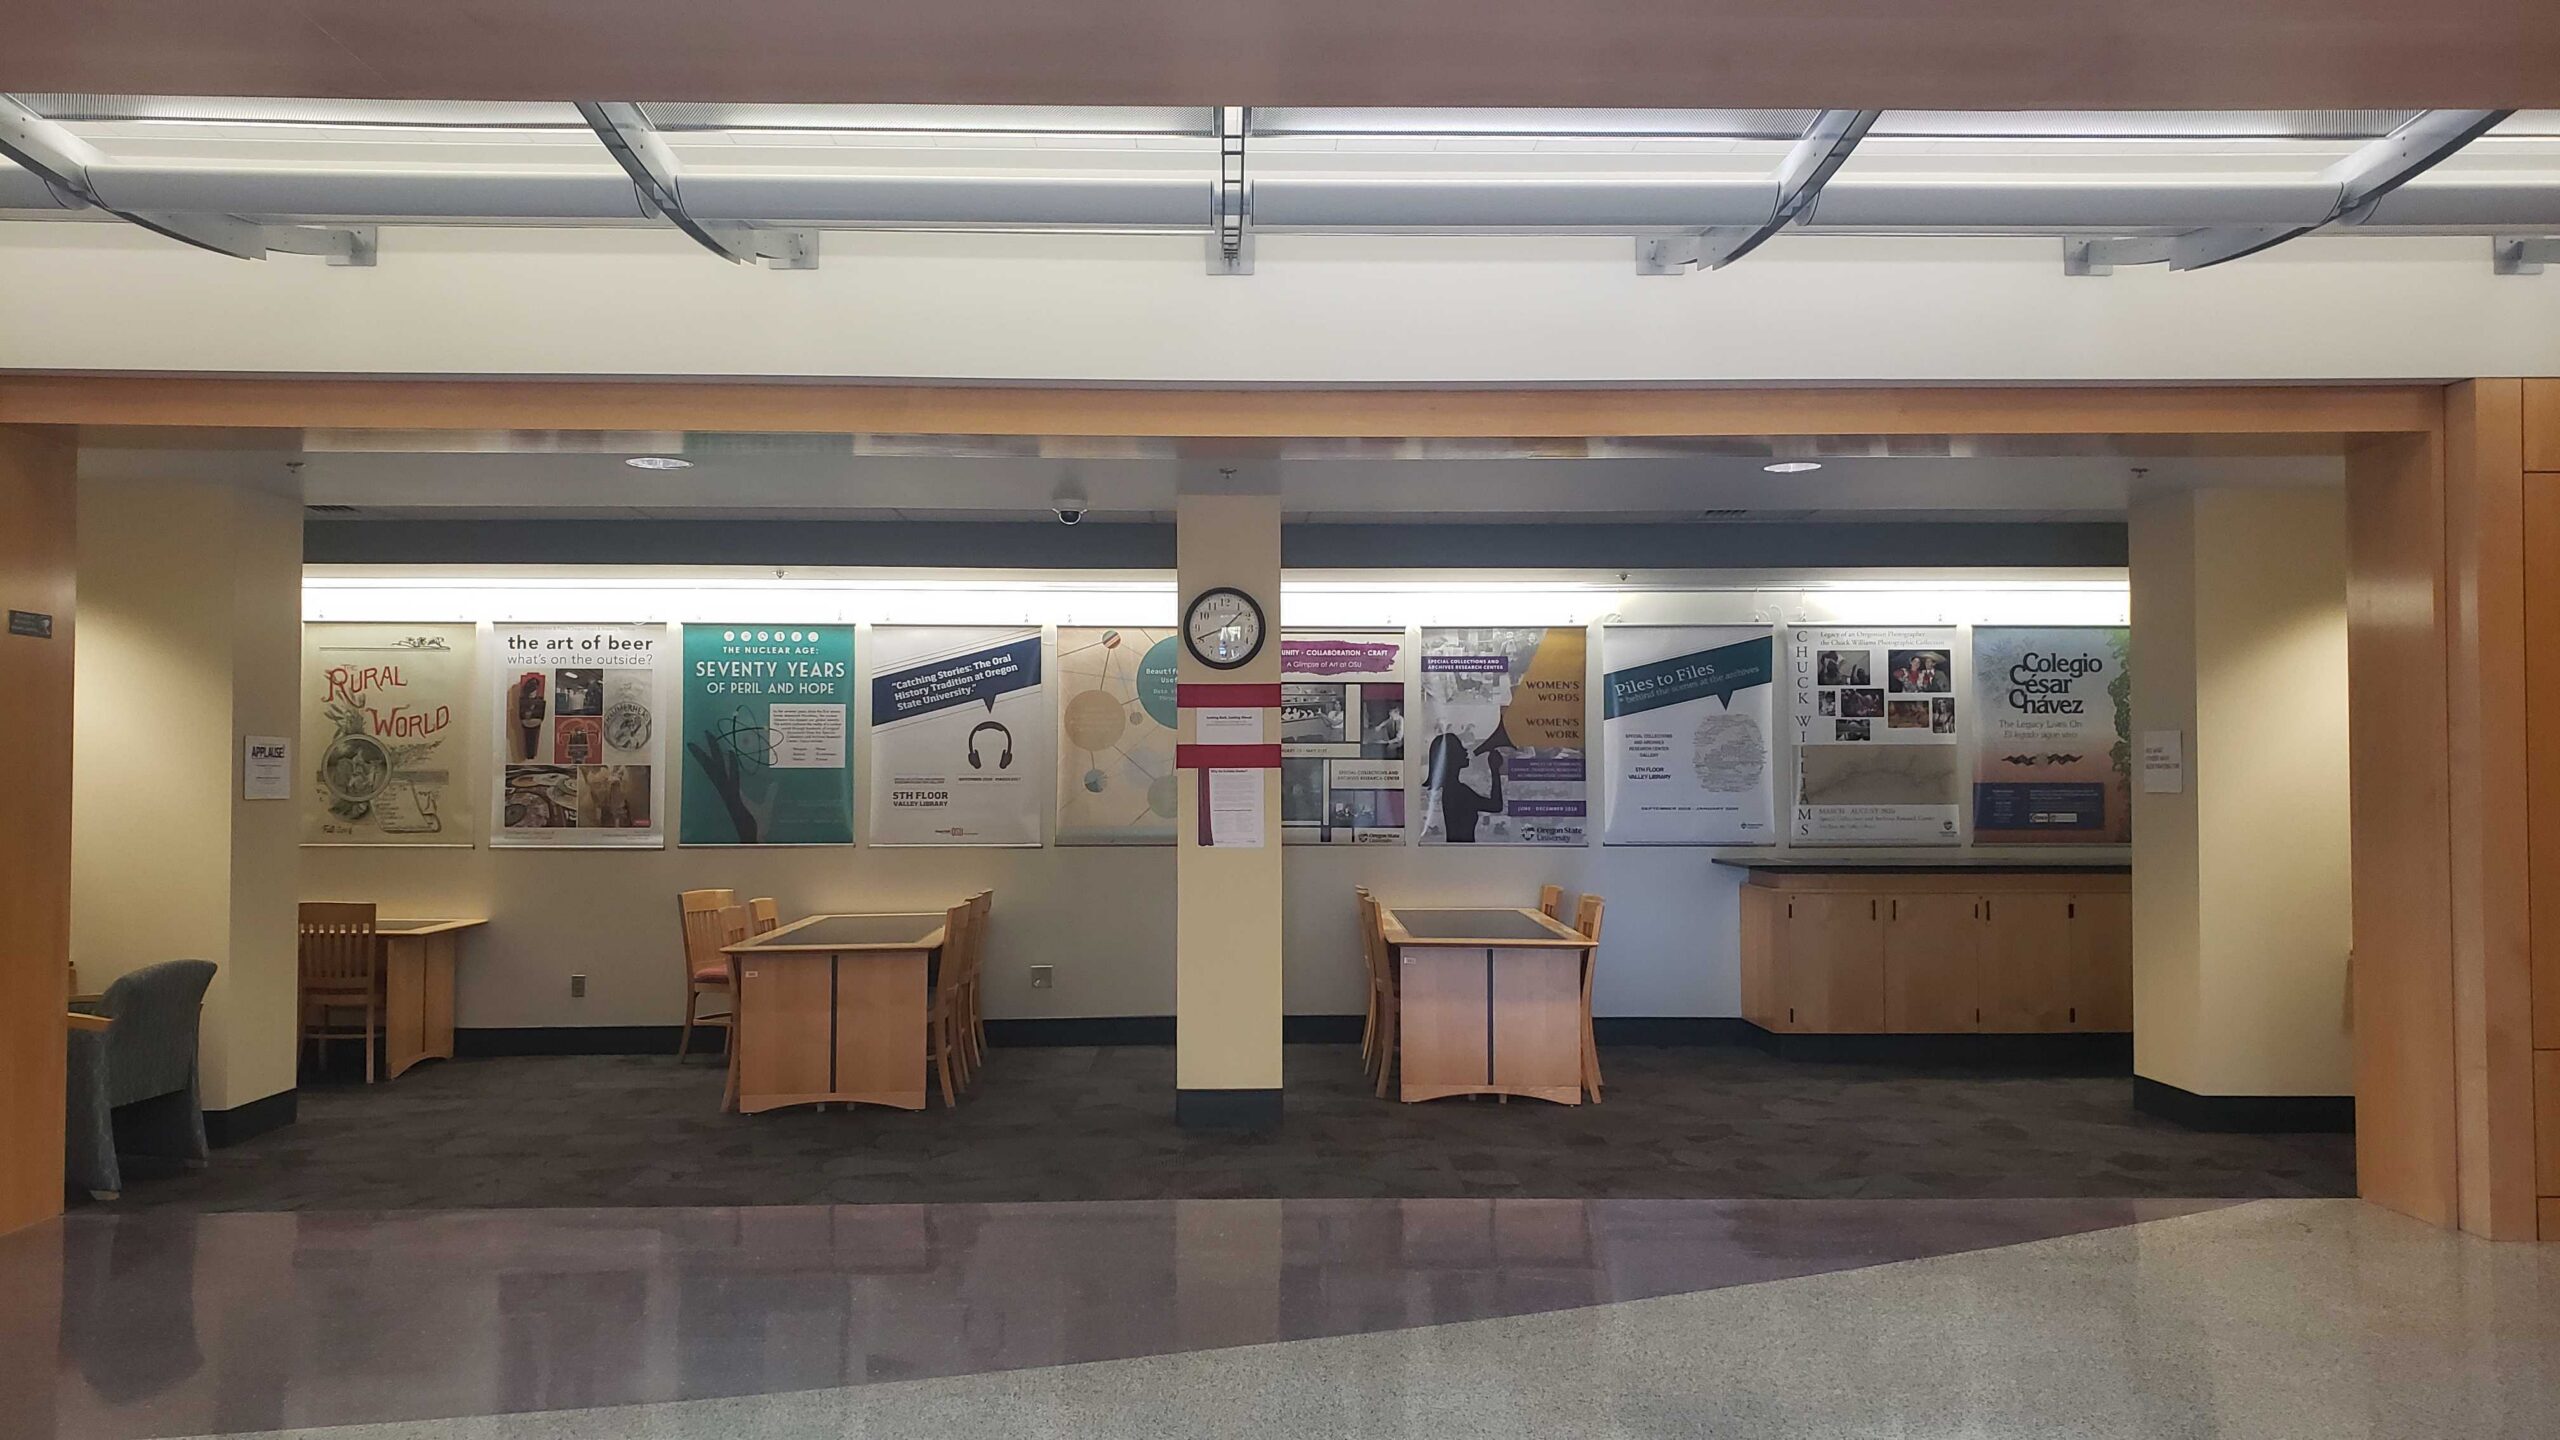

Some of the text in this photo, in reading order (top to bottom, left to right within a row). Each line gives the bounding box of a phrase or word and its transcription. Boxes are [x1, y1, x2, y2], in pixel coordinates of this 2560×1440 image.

[1208, 602, 1217, 611] 11
[1220, 598, 1230, 607] 12
[1200, 612, 1209, 620] 10
[508, 635, 653, 650] the art of beer
[723, 646, 819, 655] THE NUCLEAR AGE:
[507, 653, 653, 665] what's on the outside?
[1293, 661, 1319, 669] Glimpse
[2022, 652, 2103, 678] Colegio
[696, 661, 845, 678] SEVENTY YEARS
[937, 664, 973, 680] Stories:
[973, 660, 991, 671] The
[991, 654, 1012, 667] Oral
[894, 664, 1018, 701] History Tradition at Oregon
[1526, 681, 1579, 689] WOMEN'S
[1615, 664, 1715, 697] Piles to Files
[2009, 664, 2072, 694] César
[321, 666, 408, 708] RURAL
[707, 682, 835, 695] OF PERIL AND HOPE
[1538, 693, 1579, 702] WORDS
[2008, 688, 2084, 714] Chávez
[897, 698, 923, 711] State
[1526, 718, 1579, 726] WOMEN'S
[1545, 730, 1579, 739] WORK
[893, 791, 948, 800] 5TH FLOOR
[1537, 827, 1563, 835] Oregon
